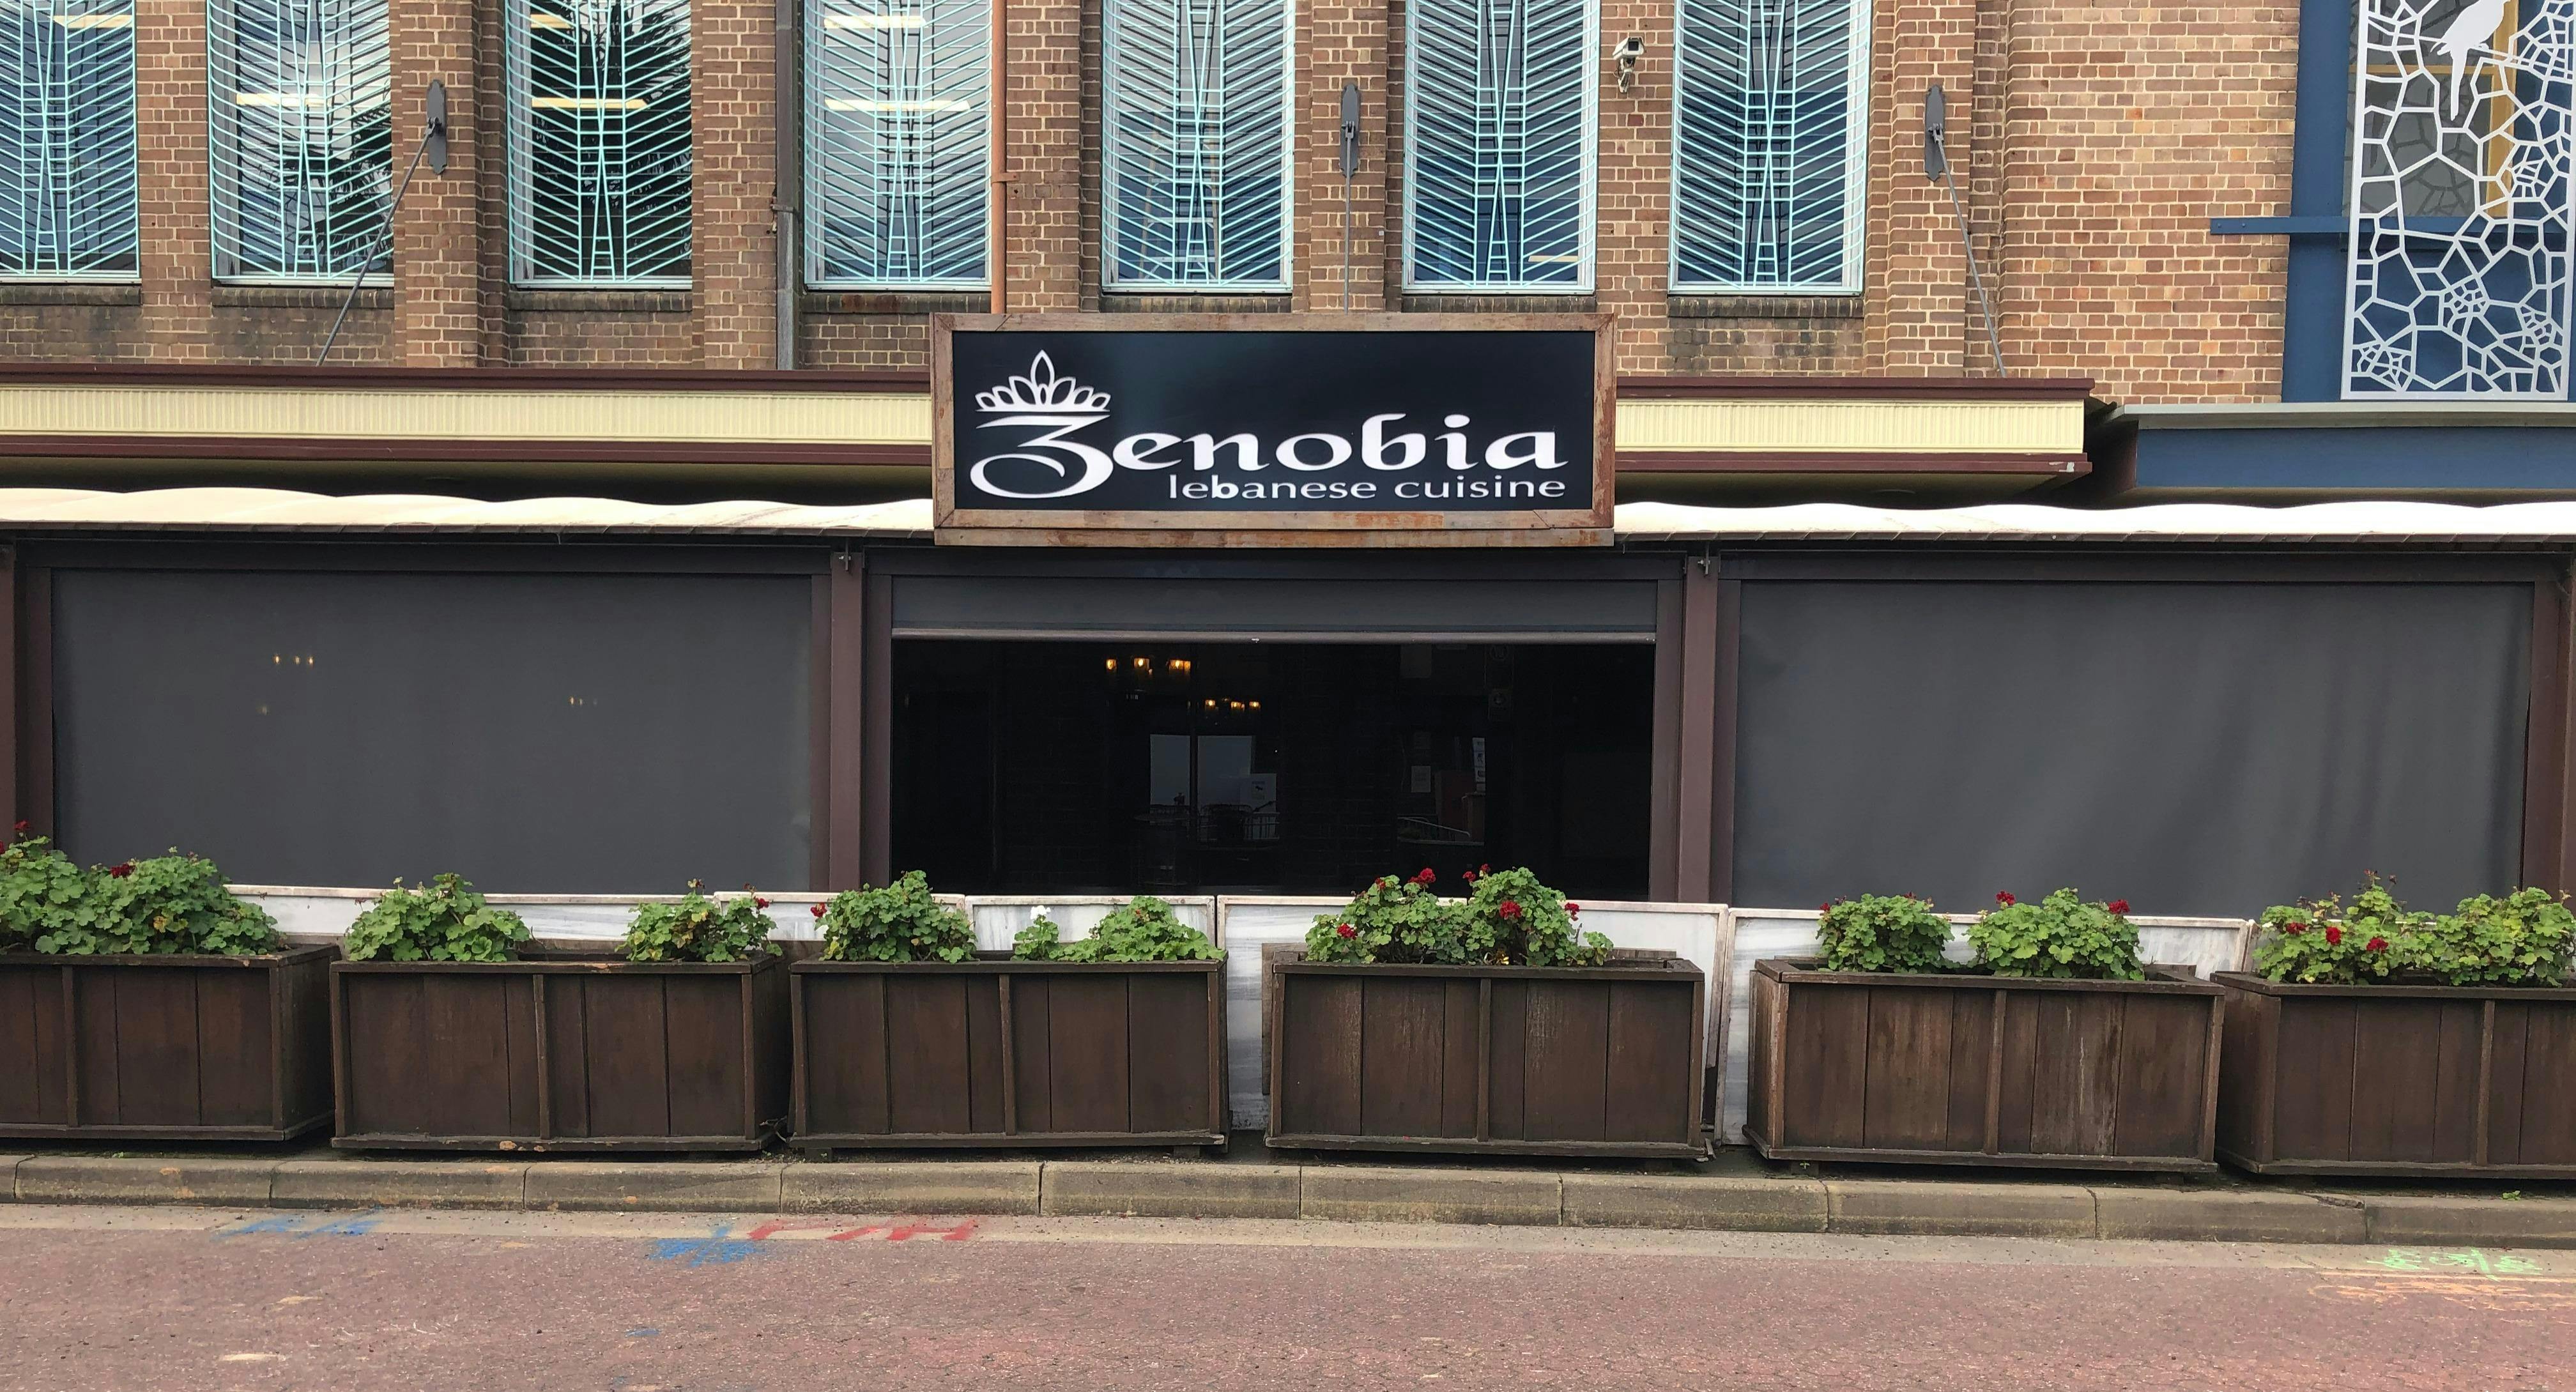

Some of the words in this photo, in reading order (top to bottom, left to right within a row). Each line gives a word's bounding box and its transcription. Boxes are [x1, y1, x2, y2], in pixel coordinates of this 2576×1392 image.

[970, 413, 1569, 499] Zenobia
[1169, 474, 1377, 500] lebanese
[1393, 474, 1566, 498] cuisine
